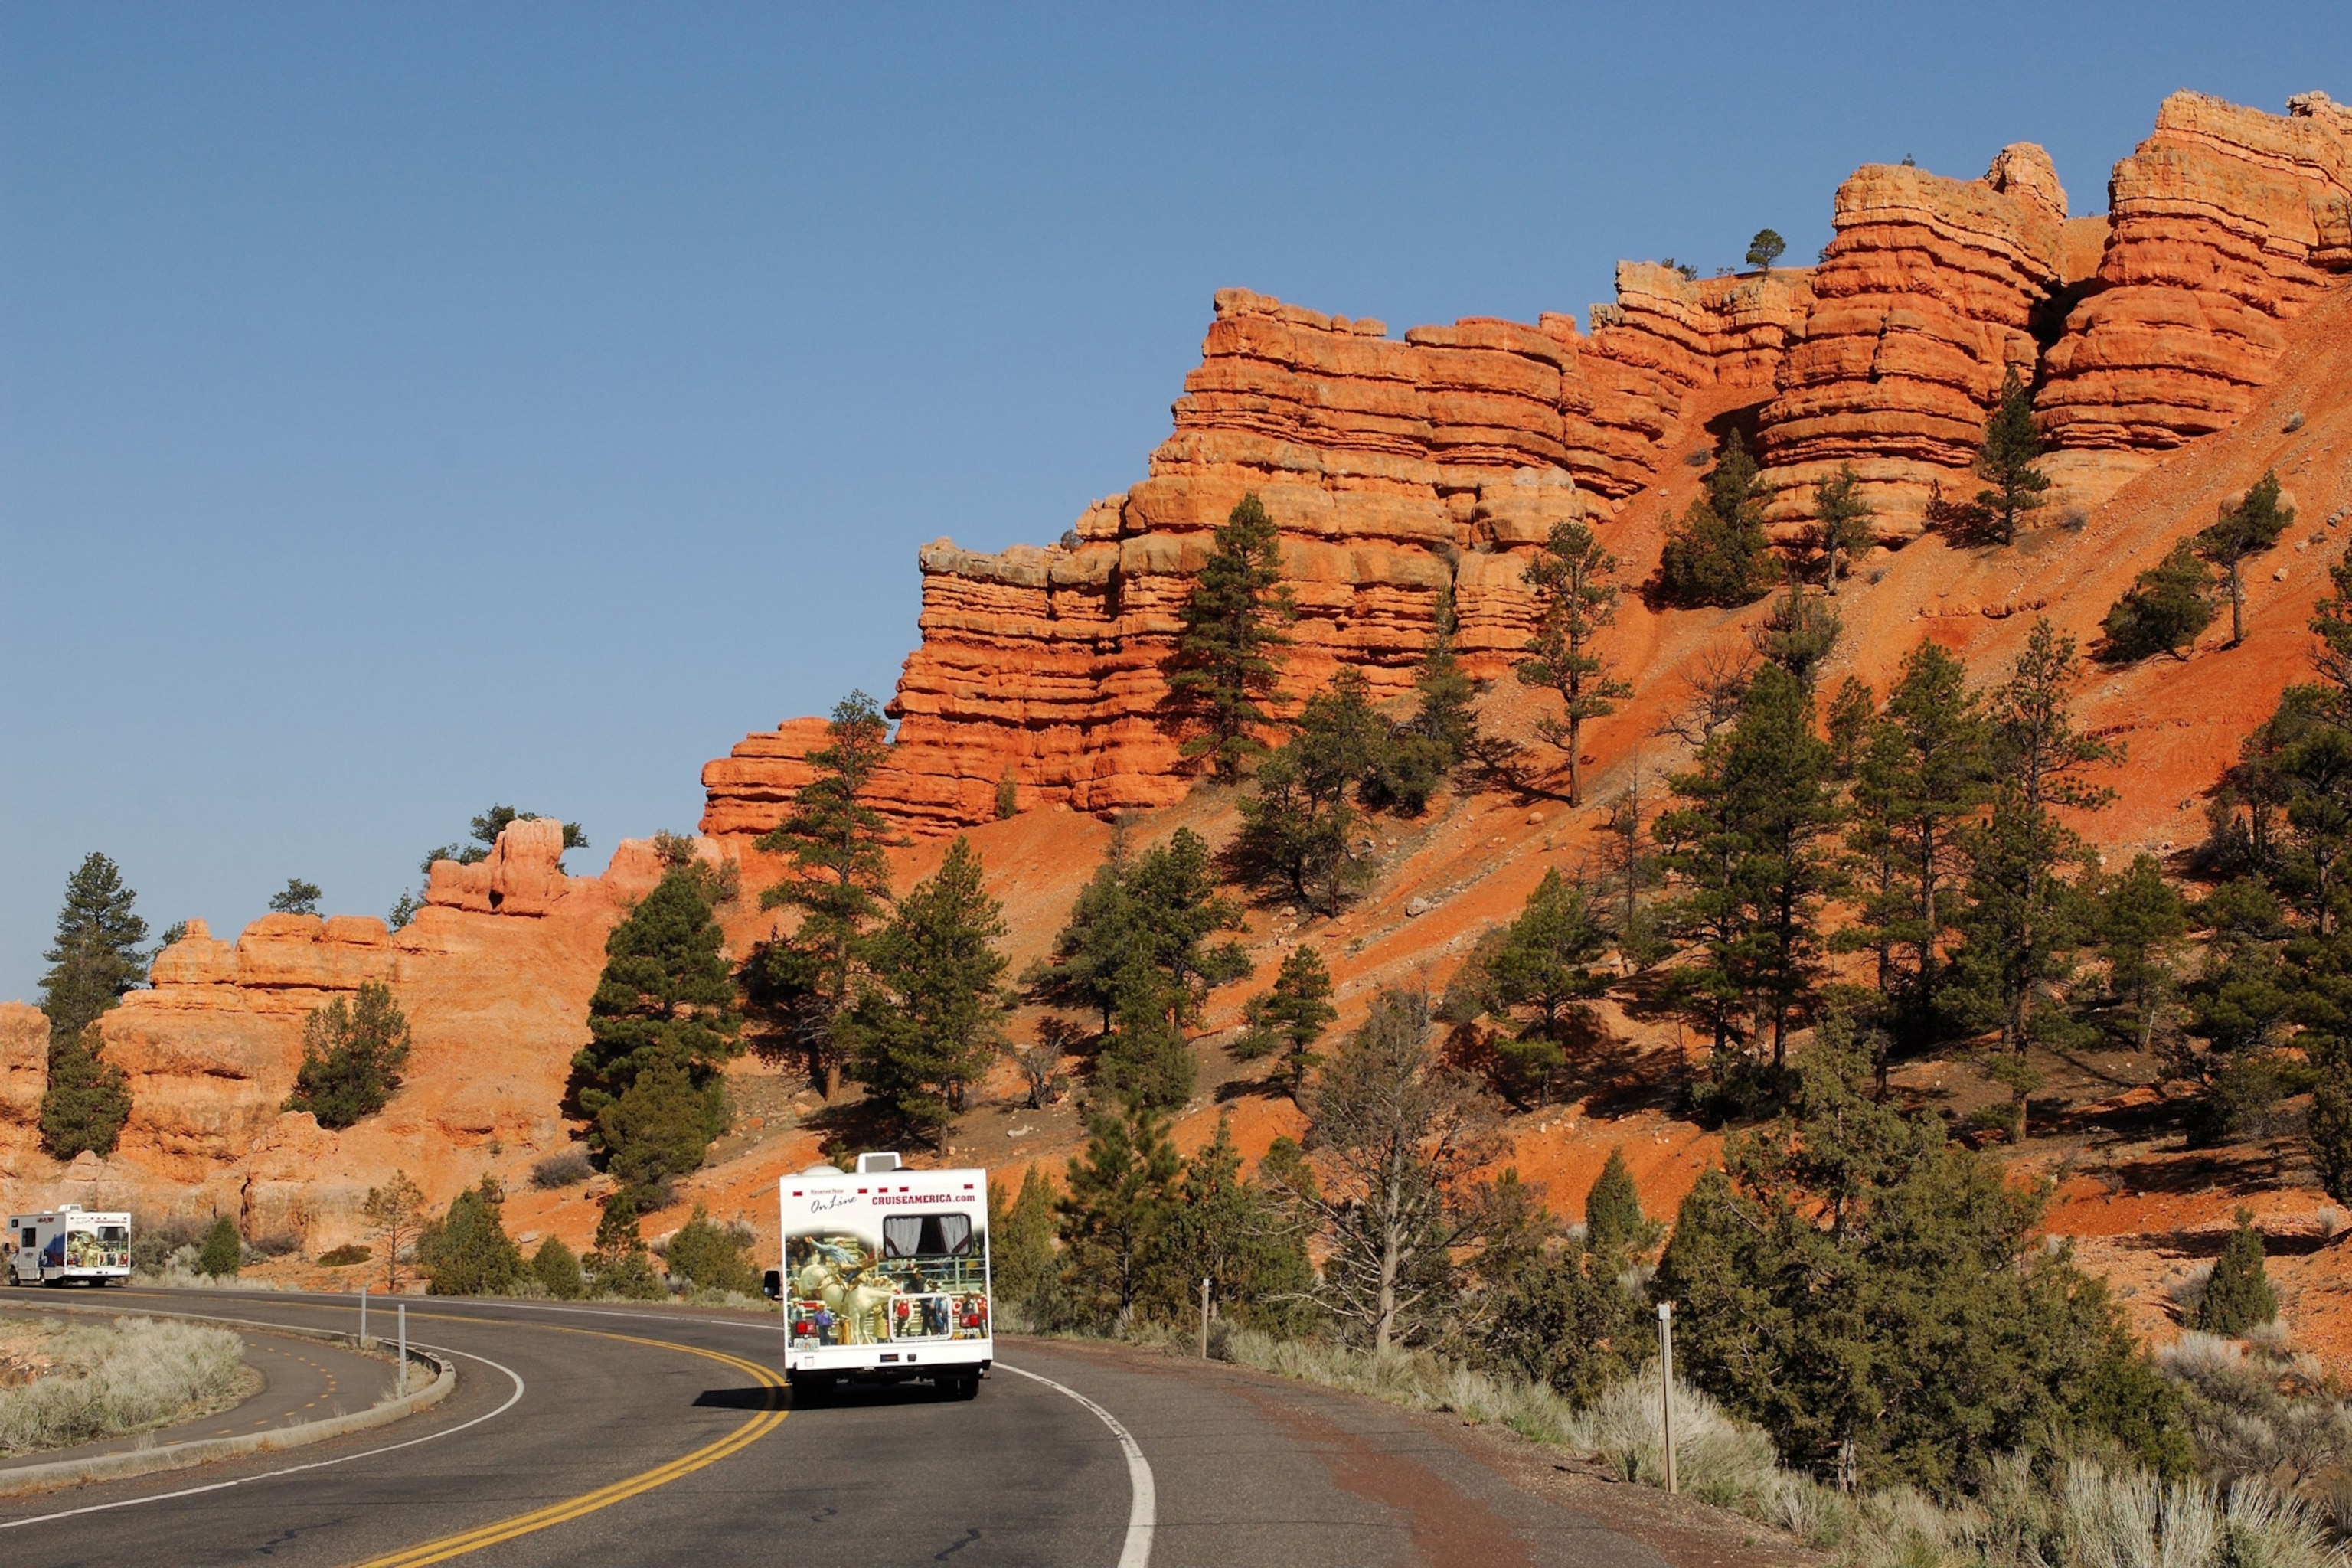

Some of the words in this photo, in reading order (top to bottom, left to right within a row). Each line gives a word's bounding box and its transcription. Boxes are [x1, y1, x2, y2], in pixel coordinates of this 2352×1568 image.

[811, 1200, 827, 1213] On
[828, 1195, 857, 1209] Line
[872, 1194, 975, 1205] CRUISEAMERICA.com
